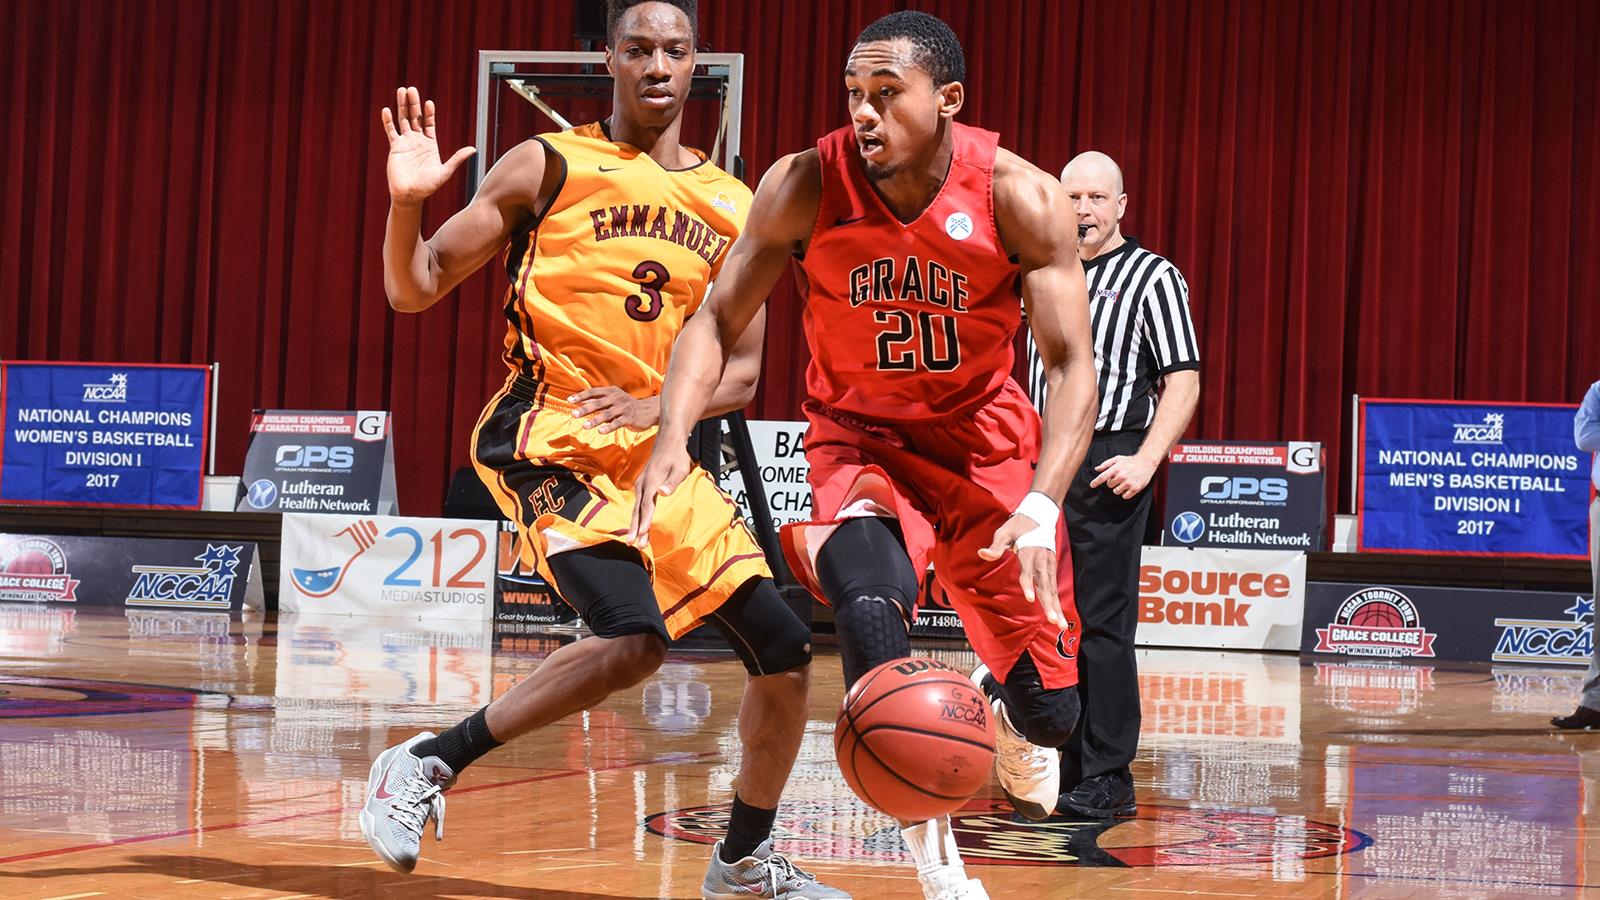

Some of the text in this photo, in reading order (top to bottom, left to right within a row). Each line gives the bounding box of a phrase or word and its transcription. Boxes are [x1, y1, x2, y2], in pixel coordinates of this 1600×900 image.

[589, 204, 728, 266] EMMANUEL
[624, 260, 670, 322] 3
[850, 256, 969, 313] GRACE
[873, 310, 961, 373] 20
[83, 387, 127, 400] NCCAA
[18, 408, 192, 426] NATIONAL CHAMPIONS
[359, 416, 381, 435] G
[15, 429, 194, 447] WOMEN'S BASKETBALL
[1454, 427, 1504, 442] NCCAA
[774, 431, 807, 458] BA
[1182, 445, 1274, 456] BUILDING CHAMPIONS
[65, 451, 142, 467] DIVISION I
[275, 445, 354, 468] OPS
[1173, 454, 1283, 464] OF CHARACTER TOGETHER
[1291, 447, 1317, 467] G
[1379, 450, 1578, 471] NATIONAL CHAMPIONS
[85, 473, 120, 488] 2017
[281, 480, 344, 496] Lutheran
[1200, 476, 1288, 502] OPS
[1390, 473, 1565, 492] MEN'S BASKETBALL
[279, 497, 371, 512] Health Network
[770, 491, 813, 512] CHA
[1434, 496, 1520, 513] DIVISION I
[1209, 512, 1280, 529] Lutheran
[1457, 520, 1495, 535] 2017
[1208, 531, 1311, 546] Health Network
[383, 526, 487, 589] 212
[22, 578, 66, 590] COLLEGE
[129, 573, 233, 602] NCCAA
[1138, 565, 1290, 598] Source
[1138, 596, 1252, 627] Bank
[1340, 590, 1415, 622] NCCAA TOURNEY TOWN
[516, 613, 525, 622] by
[525, 614, 556, 622] Maverick
[1332, 629, 1420, 645] GRACE COLLEGE
[1495, 626, 1594, 657] NCCA
[1348, 646, 1373, 654] WINONA
[941, 704, 987, 728] NCCAA
